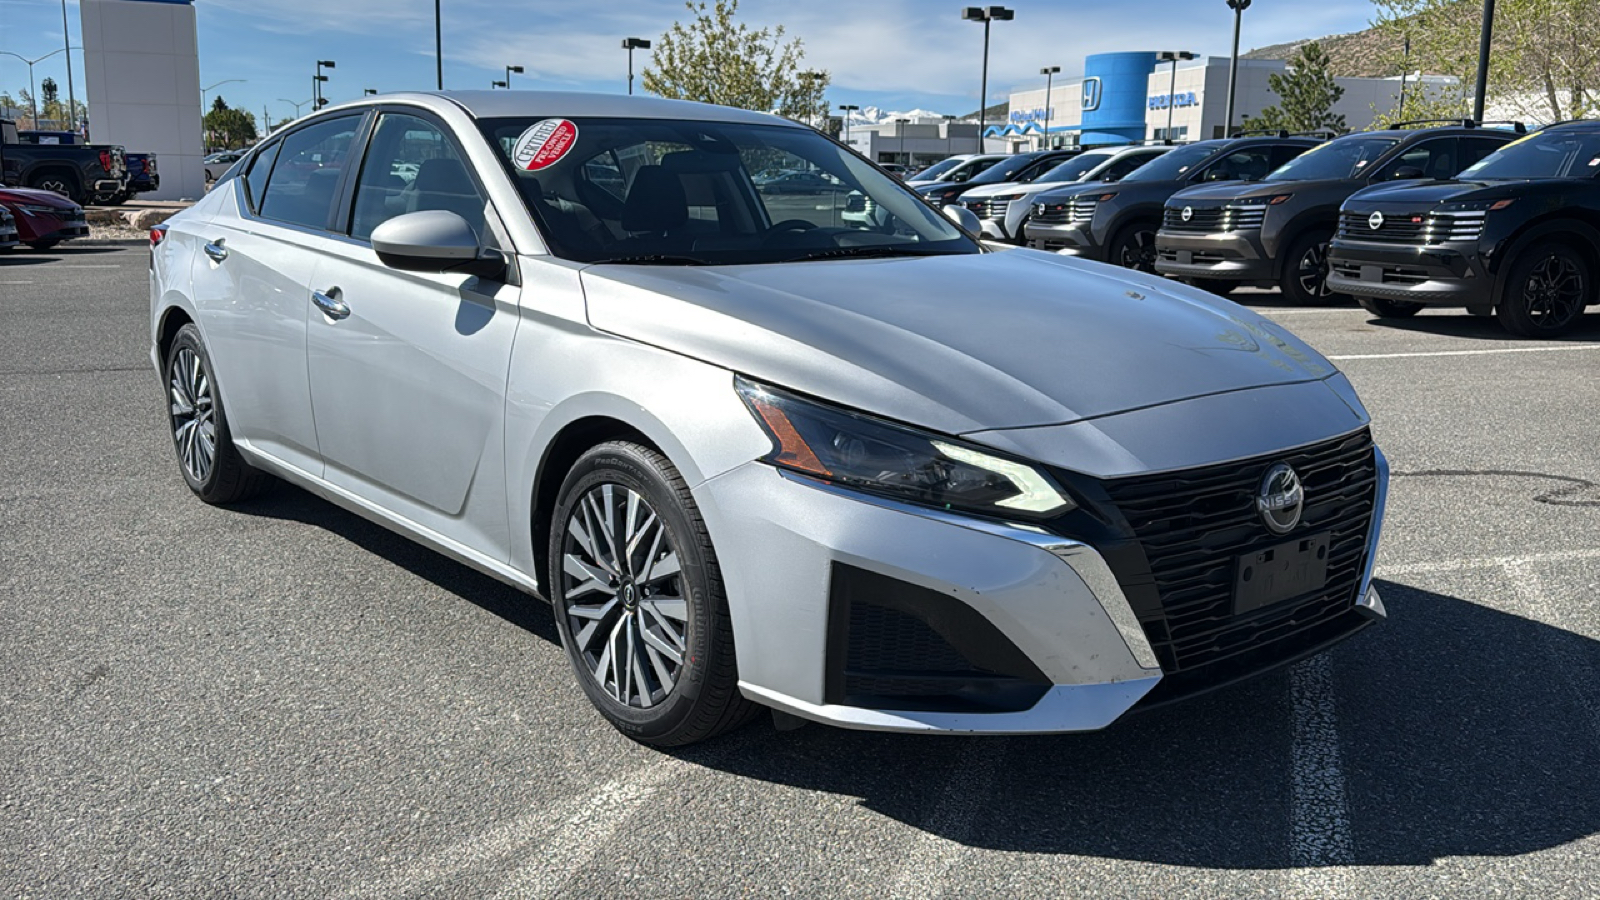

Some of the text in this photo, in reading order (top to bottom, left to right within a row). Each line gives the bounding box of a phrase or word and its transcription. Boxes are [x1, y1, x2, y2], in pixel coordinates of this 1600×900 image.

[517, 121, 558, 162] CERTIFIED
[534, 126, 568, 163] PRE-OWNED
[547, 133, 573, 158] VEHICLE
